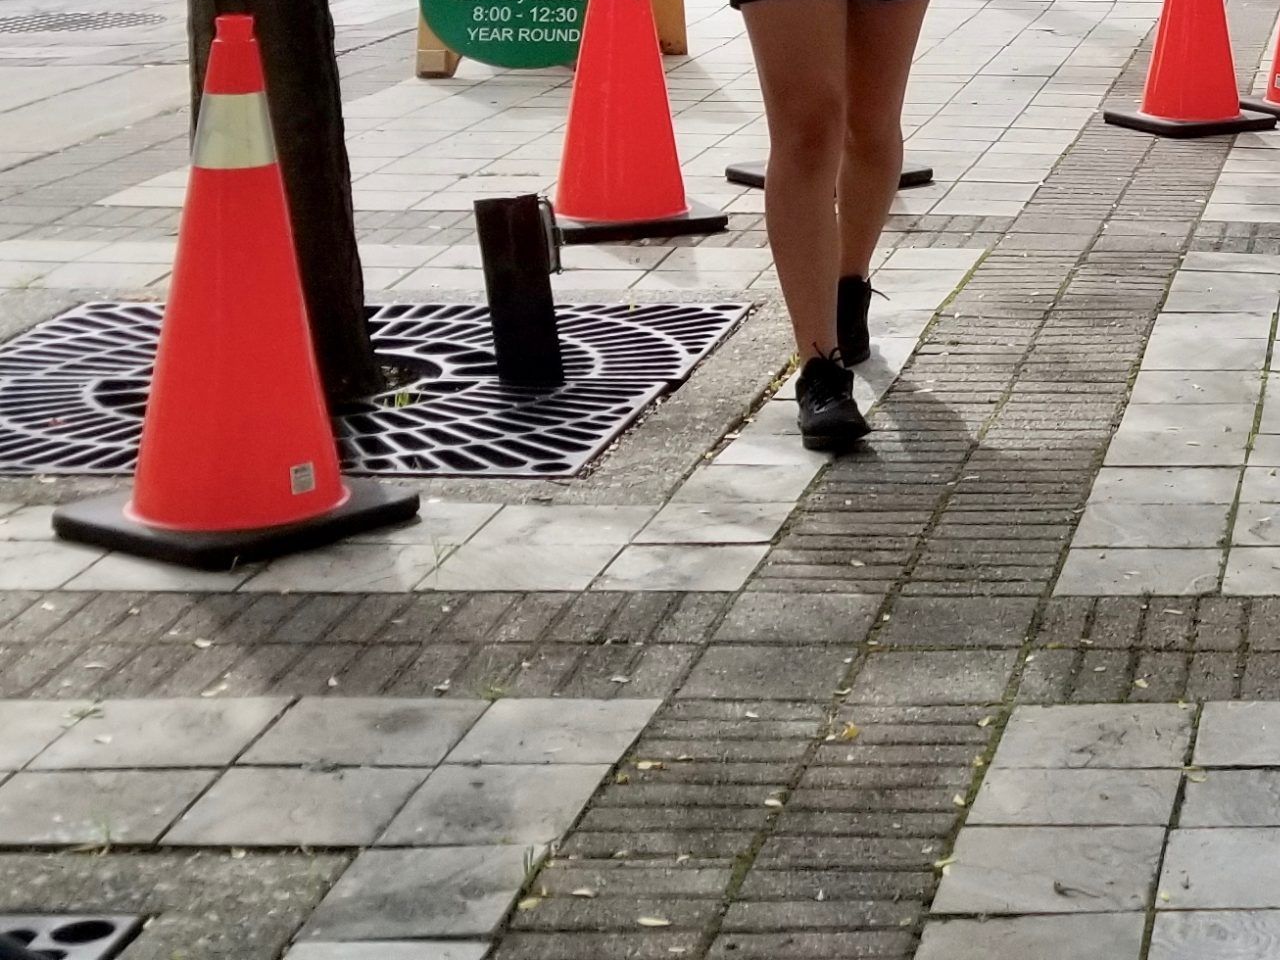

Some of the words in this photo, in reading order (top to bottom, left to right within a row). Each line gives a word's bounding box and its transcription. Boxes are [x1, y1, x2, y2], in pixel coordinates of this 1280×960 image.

[472, 6, 511, 22] 8:00
[530, 6, 577, 22] 12:30
[467, 28, 513, 41] YEAR
[518, 28, 581, 42] ROUND
